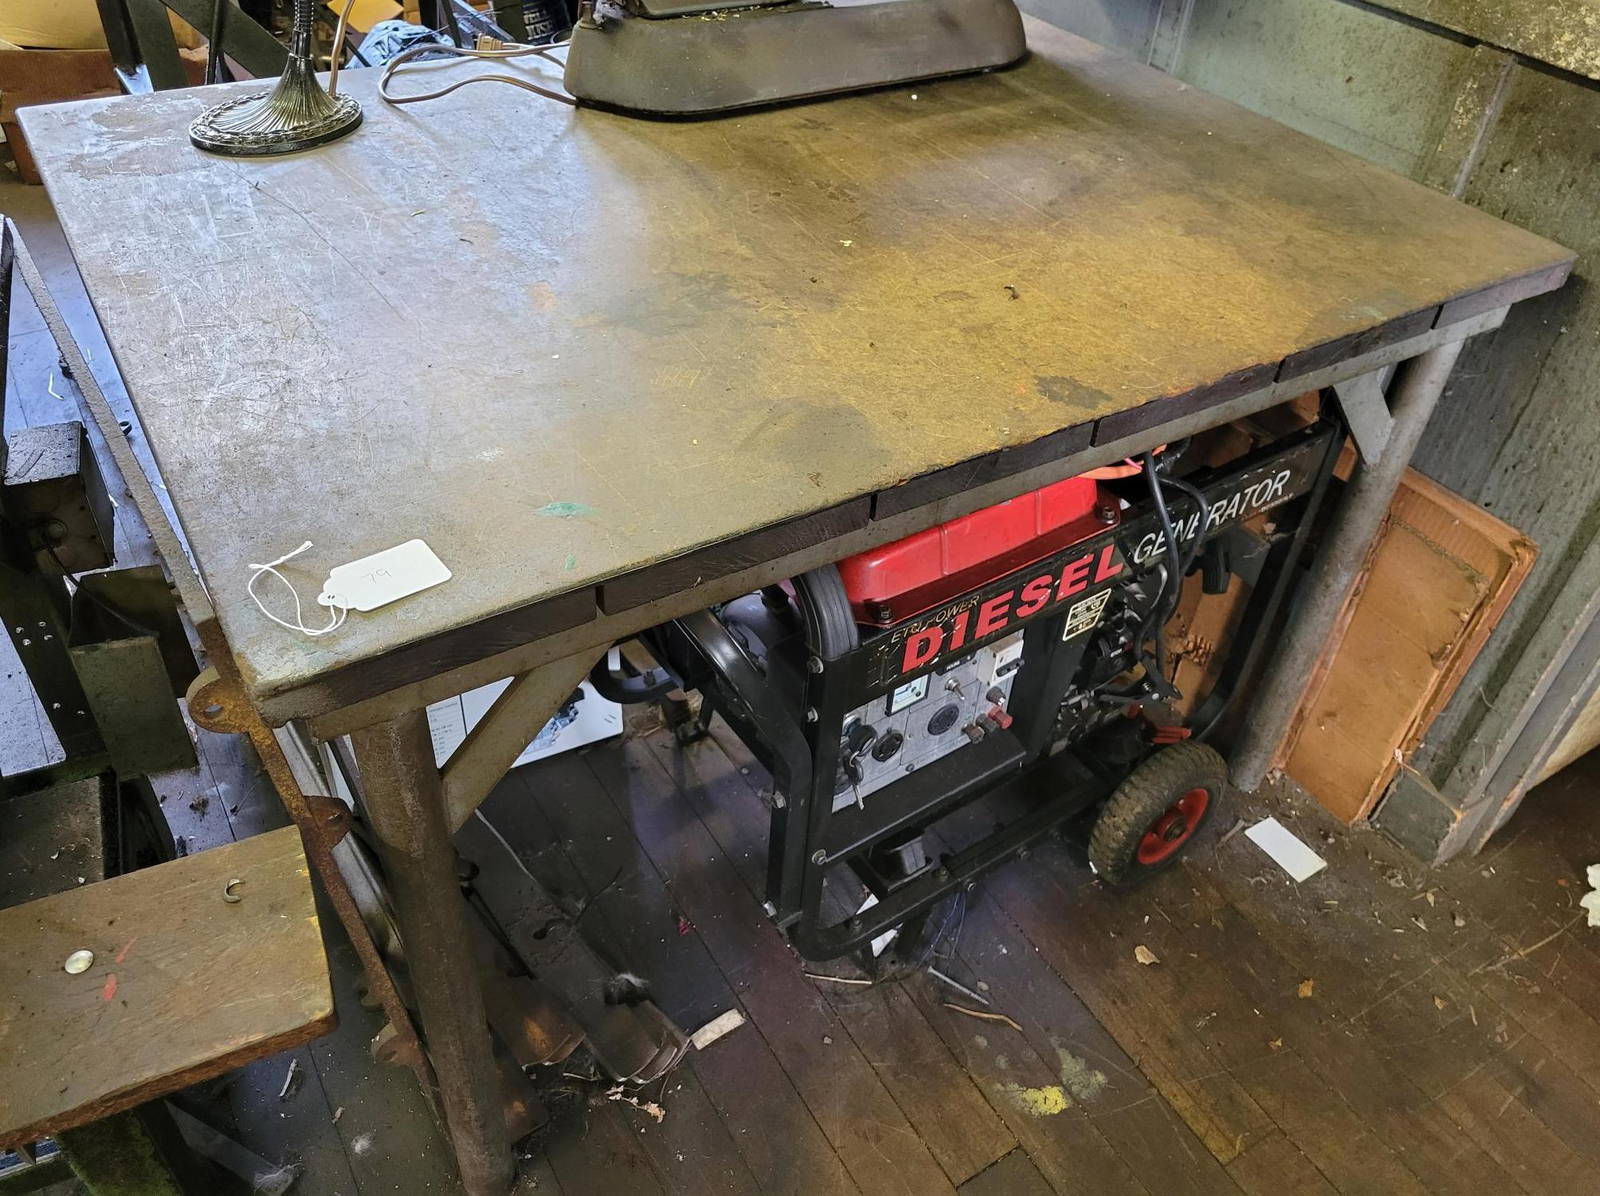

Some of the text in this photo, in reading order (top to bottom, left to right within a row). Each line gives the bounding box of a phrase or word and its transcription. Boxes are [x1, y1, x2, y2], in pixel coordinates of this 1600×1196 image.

[361, 568, 392, 585] 79
[902, 469, 1291, 674] DIESEL GENERATOR
